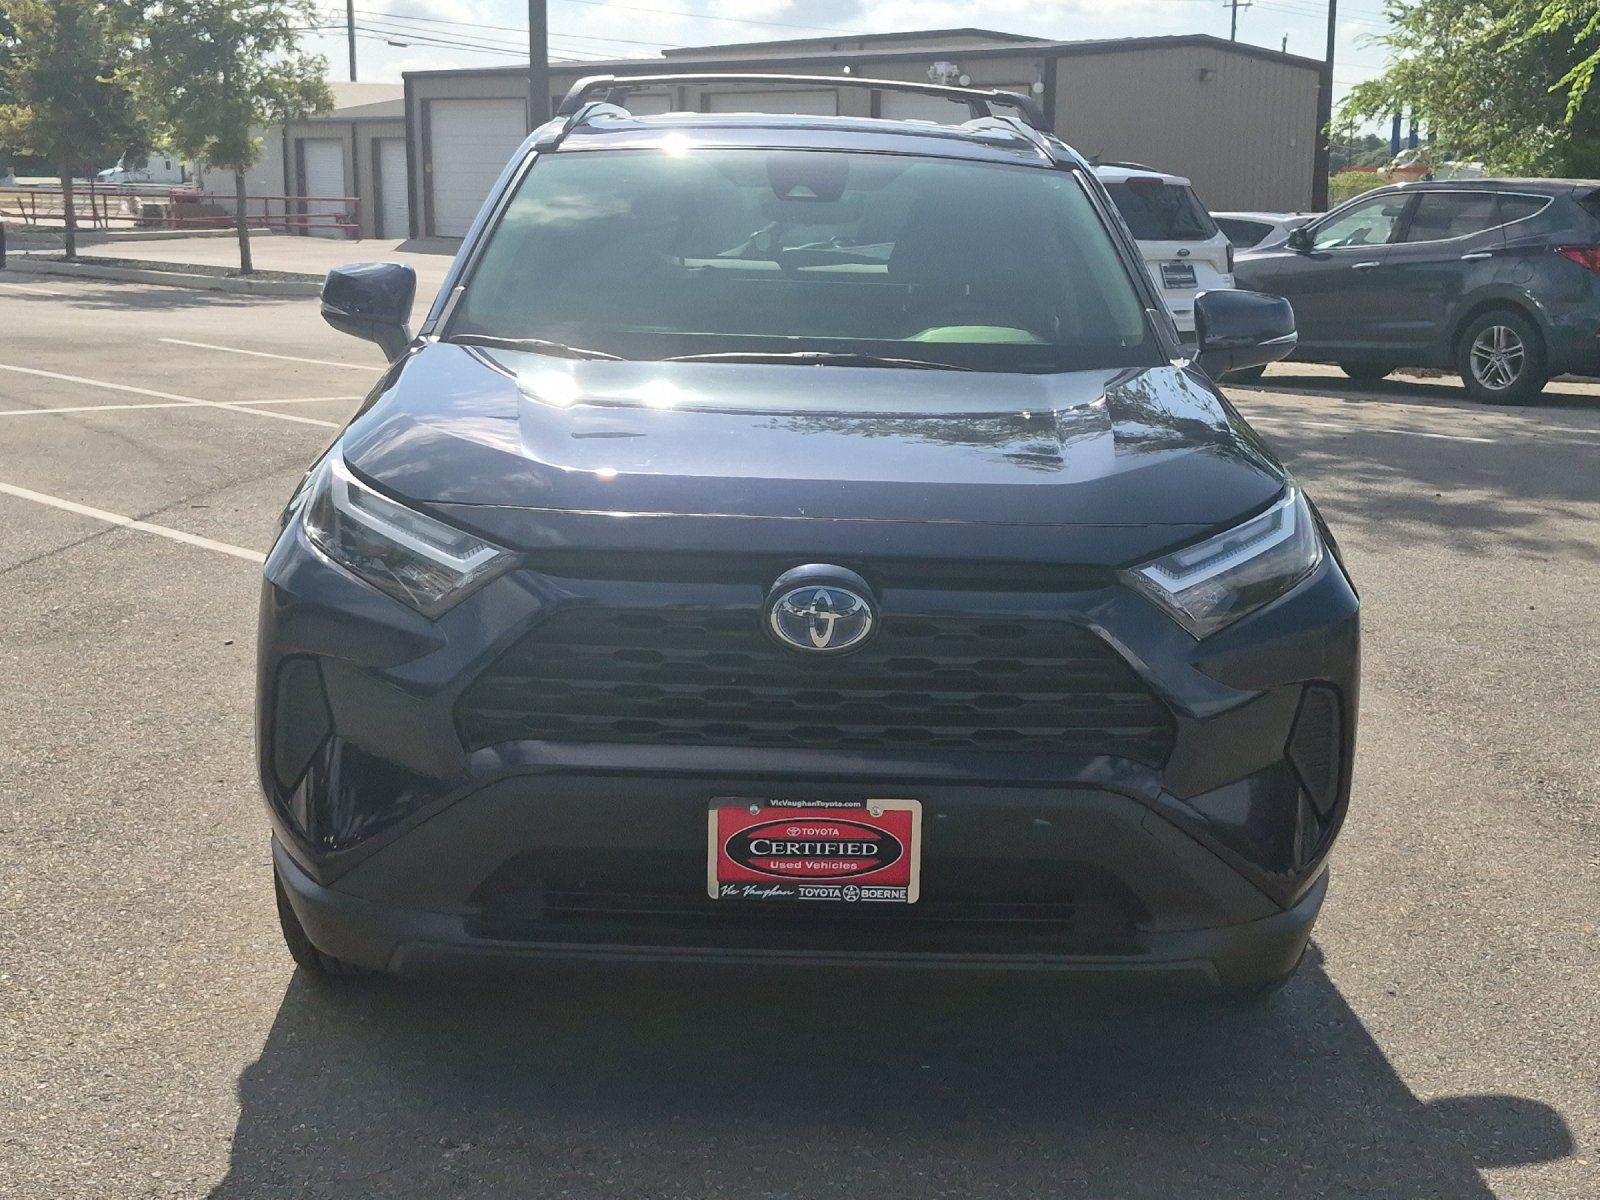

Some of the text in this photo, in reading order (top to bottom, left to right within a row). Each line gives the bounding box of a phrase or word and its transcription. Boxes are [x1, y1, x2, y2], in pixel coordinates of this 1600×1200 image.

[770, 799, 861, 808] VicVaughanToyota.com
[802, 828, 839, 836] TOYOTA
[749, 839, 878, 856] CERTIFIED
[770, 861, 858, 870] Used Vehicles
[720, 884, 739, 897] Vic
[742, 884, 795, 899] Vaughan
[799, 887, 842, 897] TOYOTA
[861, 889, 906, 899] BOERNE
